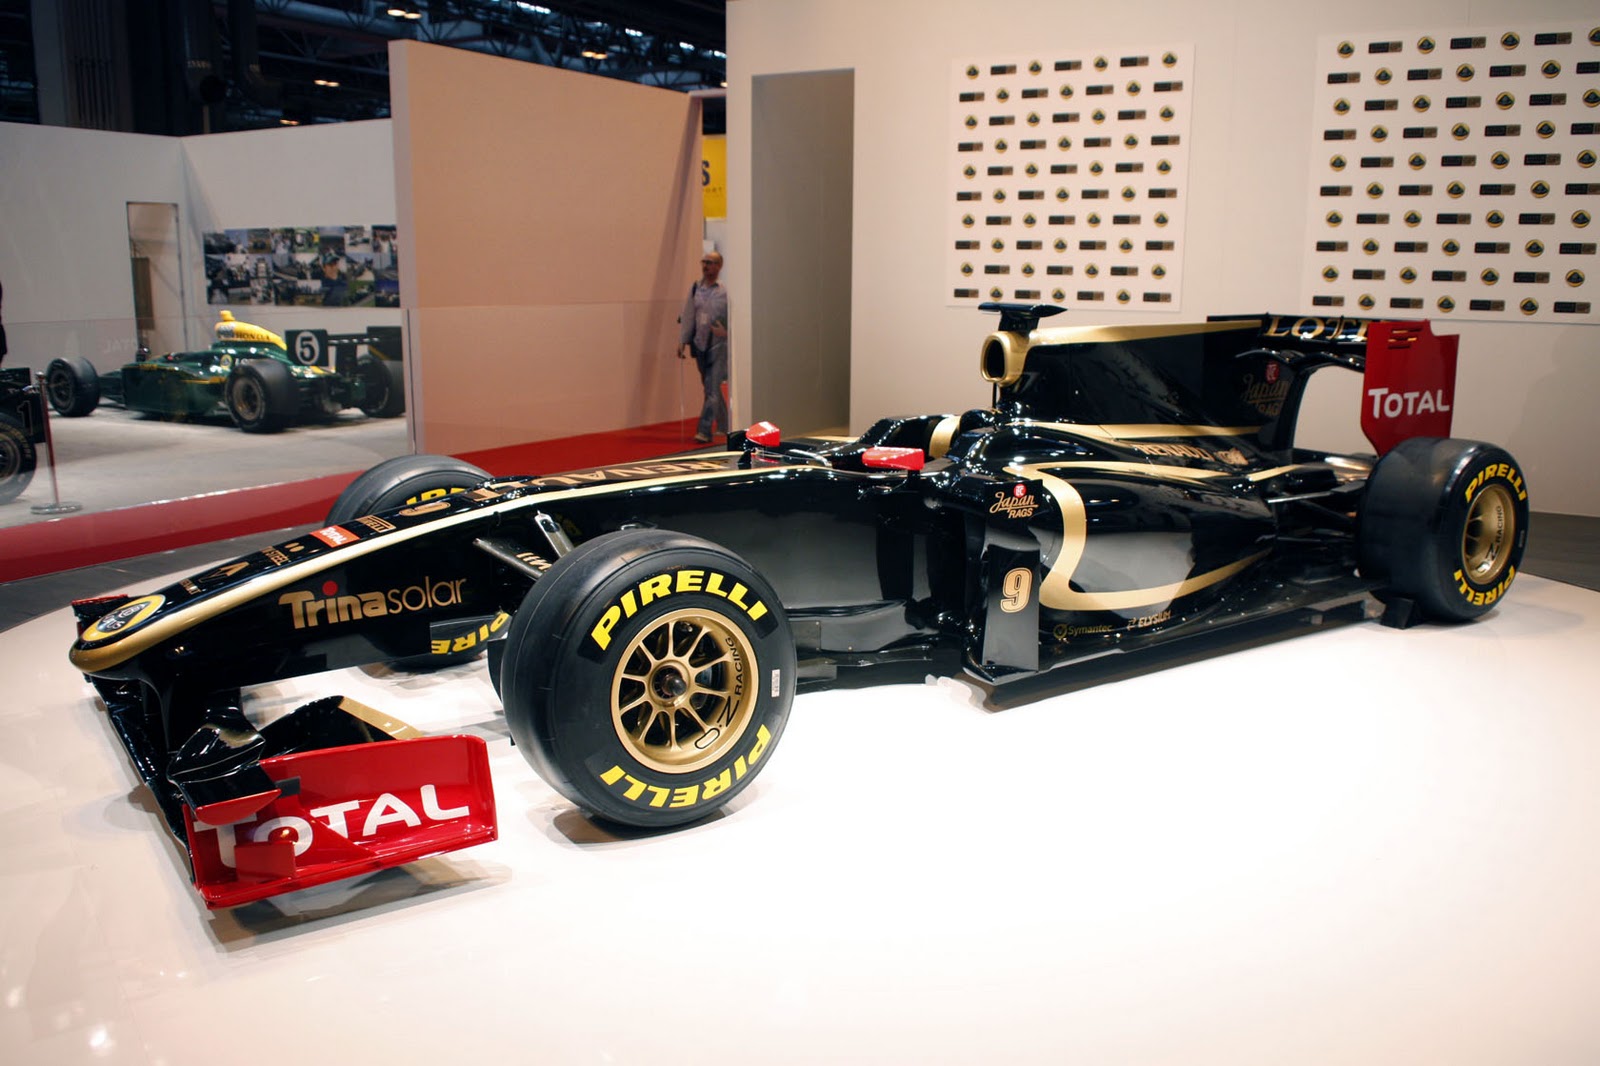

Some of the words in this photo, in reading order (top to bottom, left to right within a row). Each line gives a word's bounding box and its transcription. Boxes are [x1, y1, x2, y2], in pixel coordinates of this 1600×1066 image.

[299, 335, 315, 363] 5
[1368, 387, 1450, 420] TOTAL
[989, 491, 1039, 514] Japan
[1465, 463, 1528, 504] PIRELLI
[1008, 508, 1034, 519] RAGS
[1000, 567, 1033, 613] 9
[1453, 565, 1516, 607] PIRELLI
[591, 570, 768, 651] PIRELLI
[1068, 624, 1113, 637] Symantec
[1137, 609, 1172, 628] ELYSIUM
[431, 612, 509, 655] PIRE
[725, 637, 743, 696] RACING
[599, 724, 771, 808] PIRELLI
[193, 784, 470, 869] TOTAL
